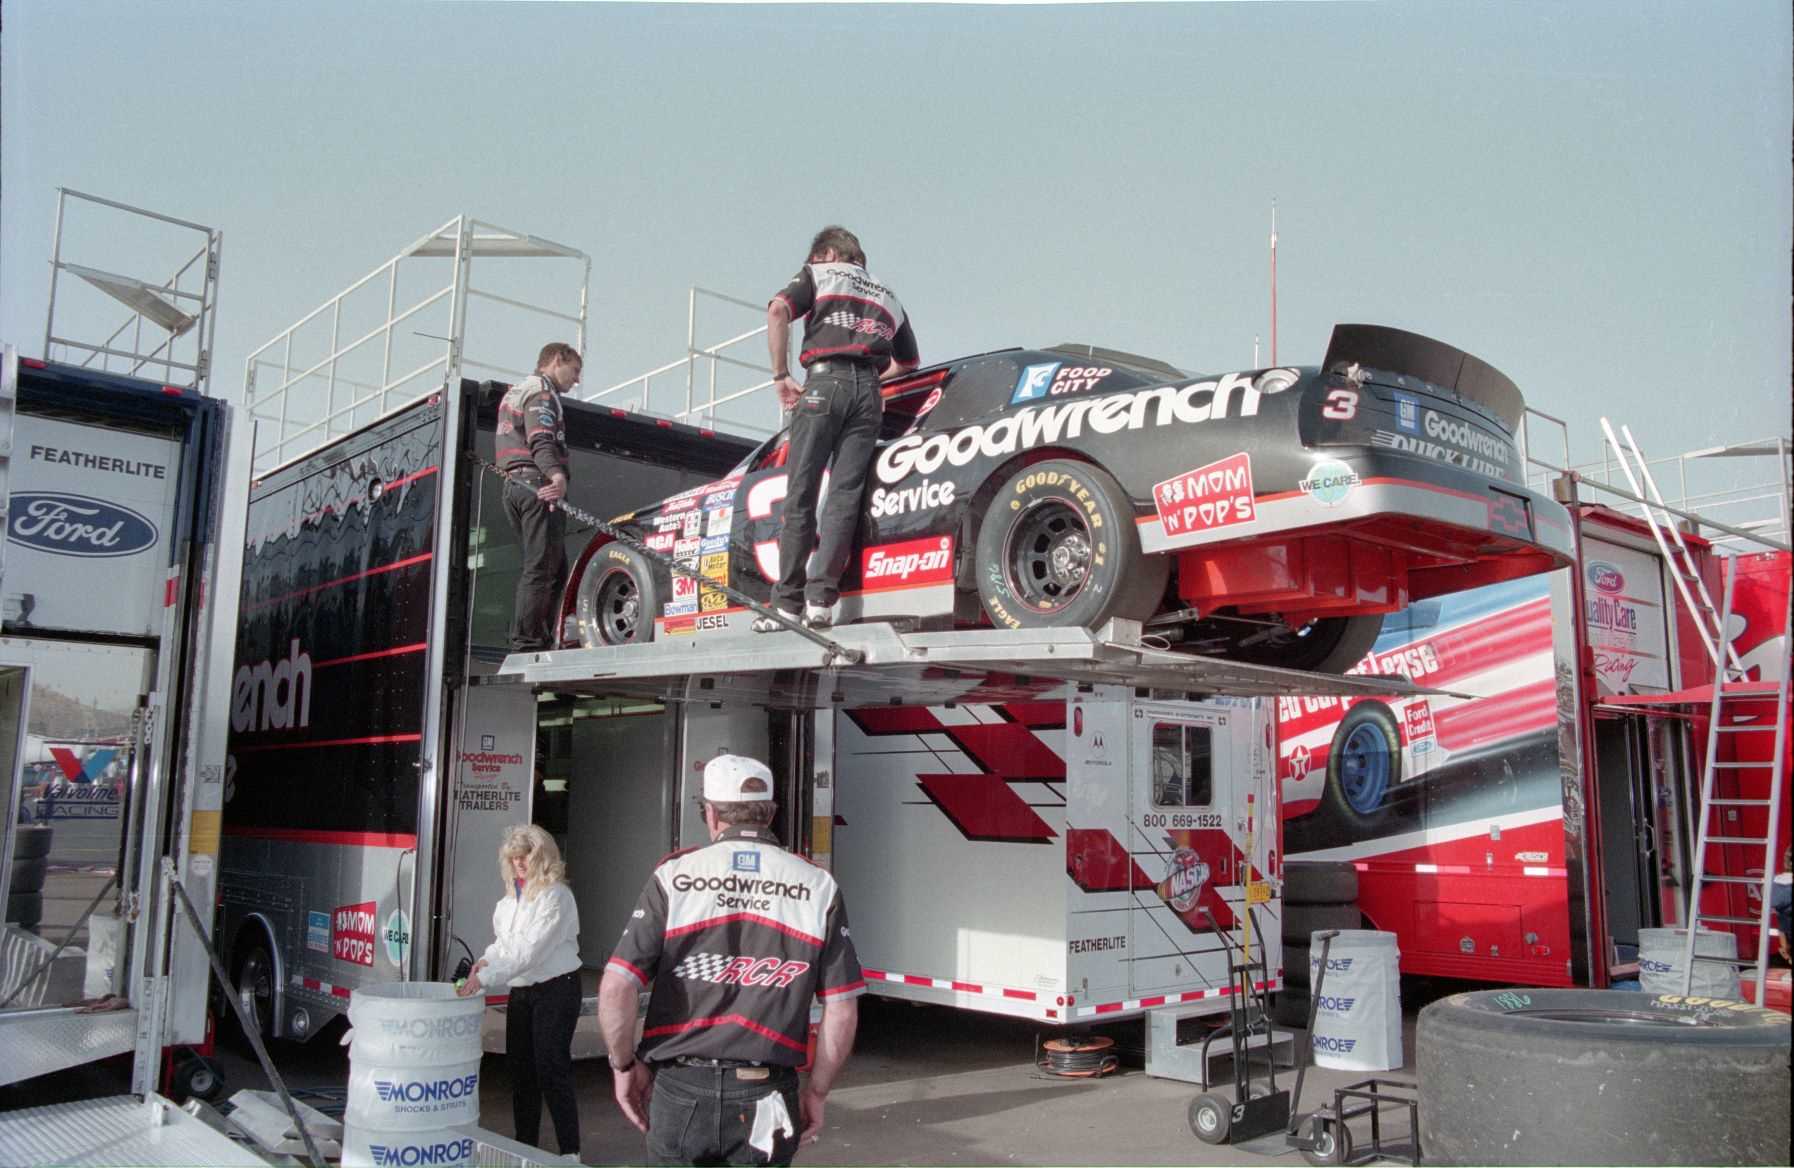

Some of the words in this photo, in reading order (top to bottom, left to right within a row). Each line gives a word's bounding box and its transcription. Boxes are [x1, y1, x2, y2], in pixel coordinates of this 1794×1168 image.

[1050, 377, 1100, 395] CITY
[1055, 367, 1113, 381] FOOD
[1321, 388, 1361, 420] 3
[876, 371, 1263, 484] Goodwrench
[1425, 410, 1510, 464] Goodwrench
[30, 444, 166, 480] FEATHERLITE
[1186, 465, 1248, 498] MOM
[1301, 479, 1321, 491] WE
[1323, 473, 1360, 488] CARE
[870, 478, 956, 518] Service
[1015, 471, 1104, 528] GOODYEAR
[13, 499, 125, 547] Ford
[1183, 496, 1253, 529] POP'S
[864, 546, 950, 580] Snap-on
[675, 576, 695, 596] 3M
[1593, 566, 1618, 587] Ford
[695, 615, 729, 630] JESEL
[1406, 704, 1428, 722] Ford
[460, 800, 511, 811] TRAILERS
[1143, 813, 1167, 828] 800
[1172, 814, 1223, 829] 669-1522
[737, 853, 756, 868] GM
[672, 873, 811, 902] Goodwrench
[716, 893, 771, 911] Service
[347, 911, 375, 935] MOM
[1068, 935, 1127, 955] FEATHERLITE
[713, 956, 811, 988] RCR
[384, 1075, 477, 1103] MONROE
[394, 1104, 431, 1113] SHOCKS
[1231, 1104, 1246, 1124] 3
[381, 1138, 474, 1167] MONROE
